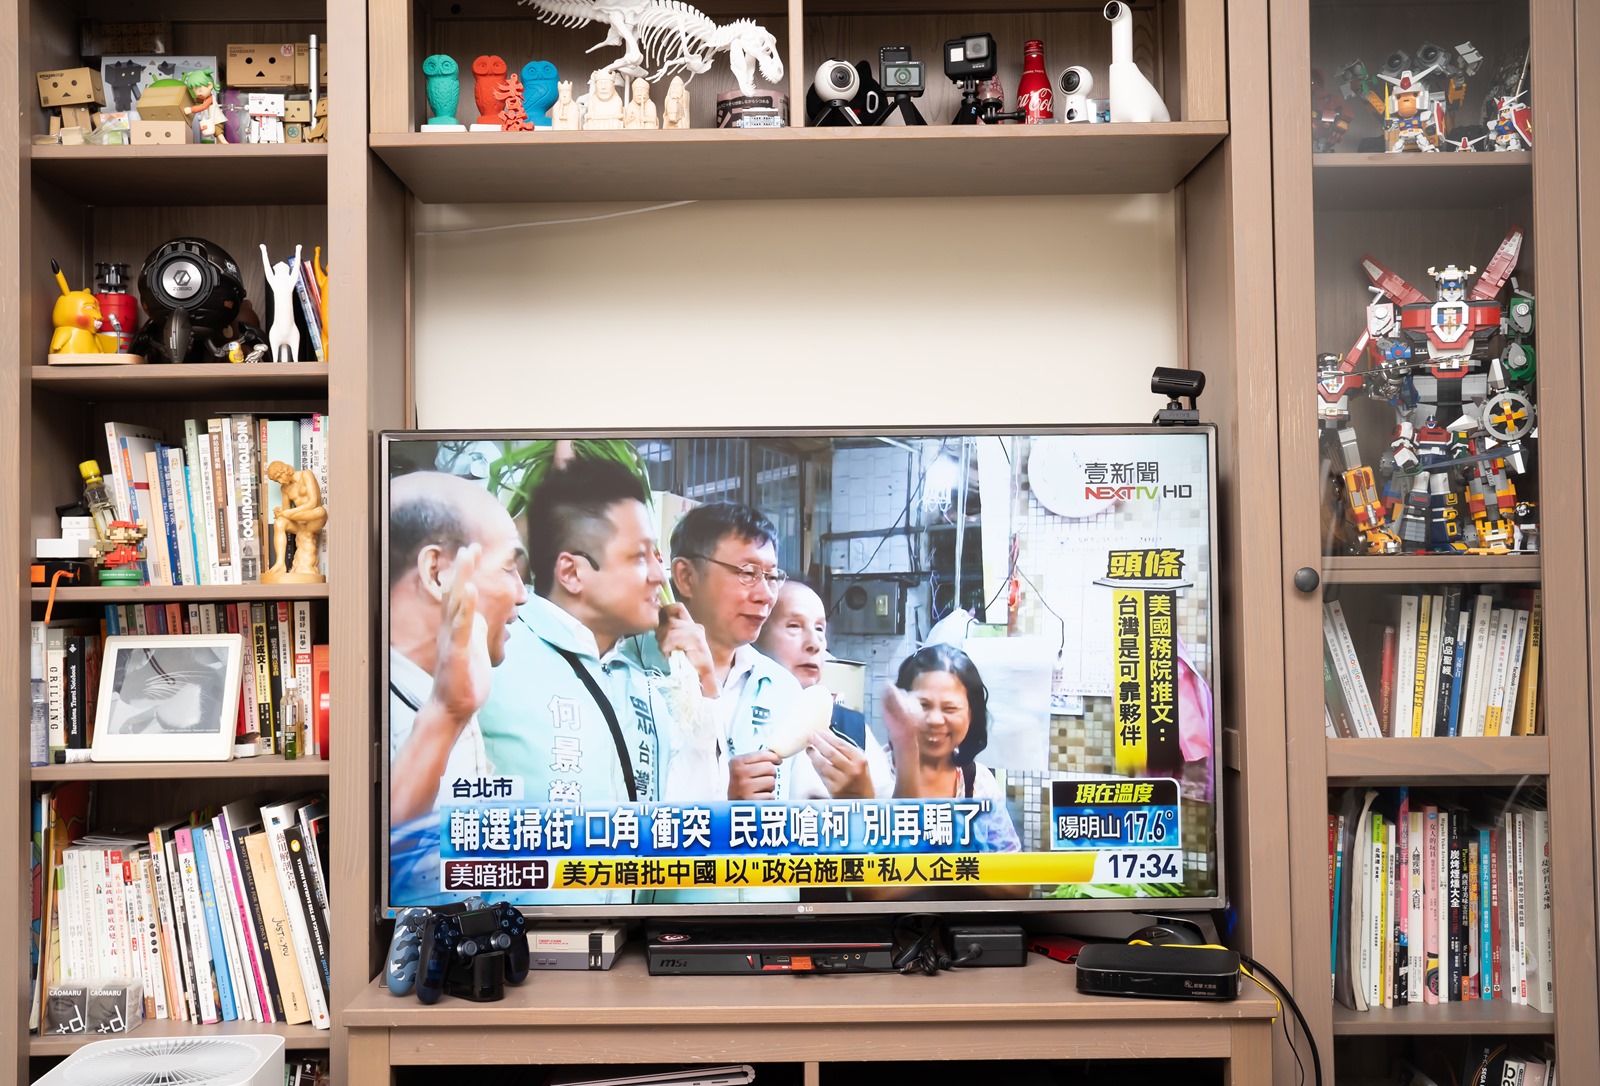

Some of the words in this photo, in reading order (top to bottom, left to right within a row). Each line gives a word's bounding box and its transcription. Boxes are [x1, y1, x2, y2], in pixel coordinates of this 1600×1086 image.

[1084, 462, 1159, 484] 壹新聞
[174, 479, 183, 511] OWLS
[1163, 485, 1192, 498] HD
[1108, 549, 1183, 579] 頭條
[1118, 595, 1142, 746] 台灣是可靠夥伴
[1348, 653, 1361, 681] Google
[1442, 636, 1454, 676] 肉品聖經
[49, 666, 59, 730] GRILLING
[452, 777, 513, 799] 台北市
[1075, 783, 1154, 804] 現在溫度
[450, 804, 712, 851] 輔選掃街"口角"衝突
[1058, 815, 1120, 840] 陽明山
[1429, 823, 1438, 858] 女人的玩具
[450, 862, 545, 888] 美暗批中
[562, 860, 716, 887] 美方暗批中國
[724, 857, 980, 885] 以"政治施壓"私人企業
[1108, 853, 1179, 879] 17:34
[1412, 846, 1421, 875] 人體疾病
[1450, 850, 1460, 908] 炭烤煙燻大全
[246, 871, 254, 885] SALE
[254, 903, 264, 923] PROMO
[259, 924, 268, 940] ONLY
[1412, 889, 1421, 910] 大百科
[660, 959, 688, 968] msi
